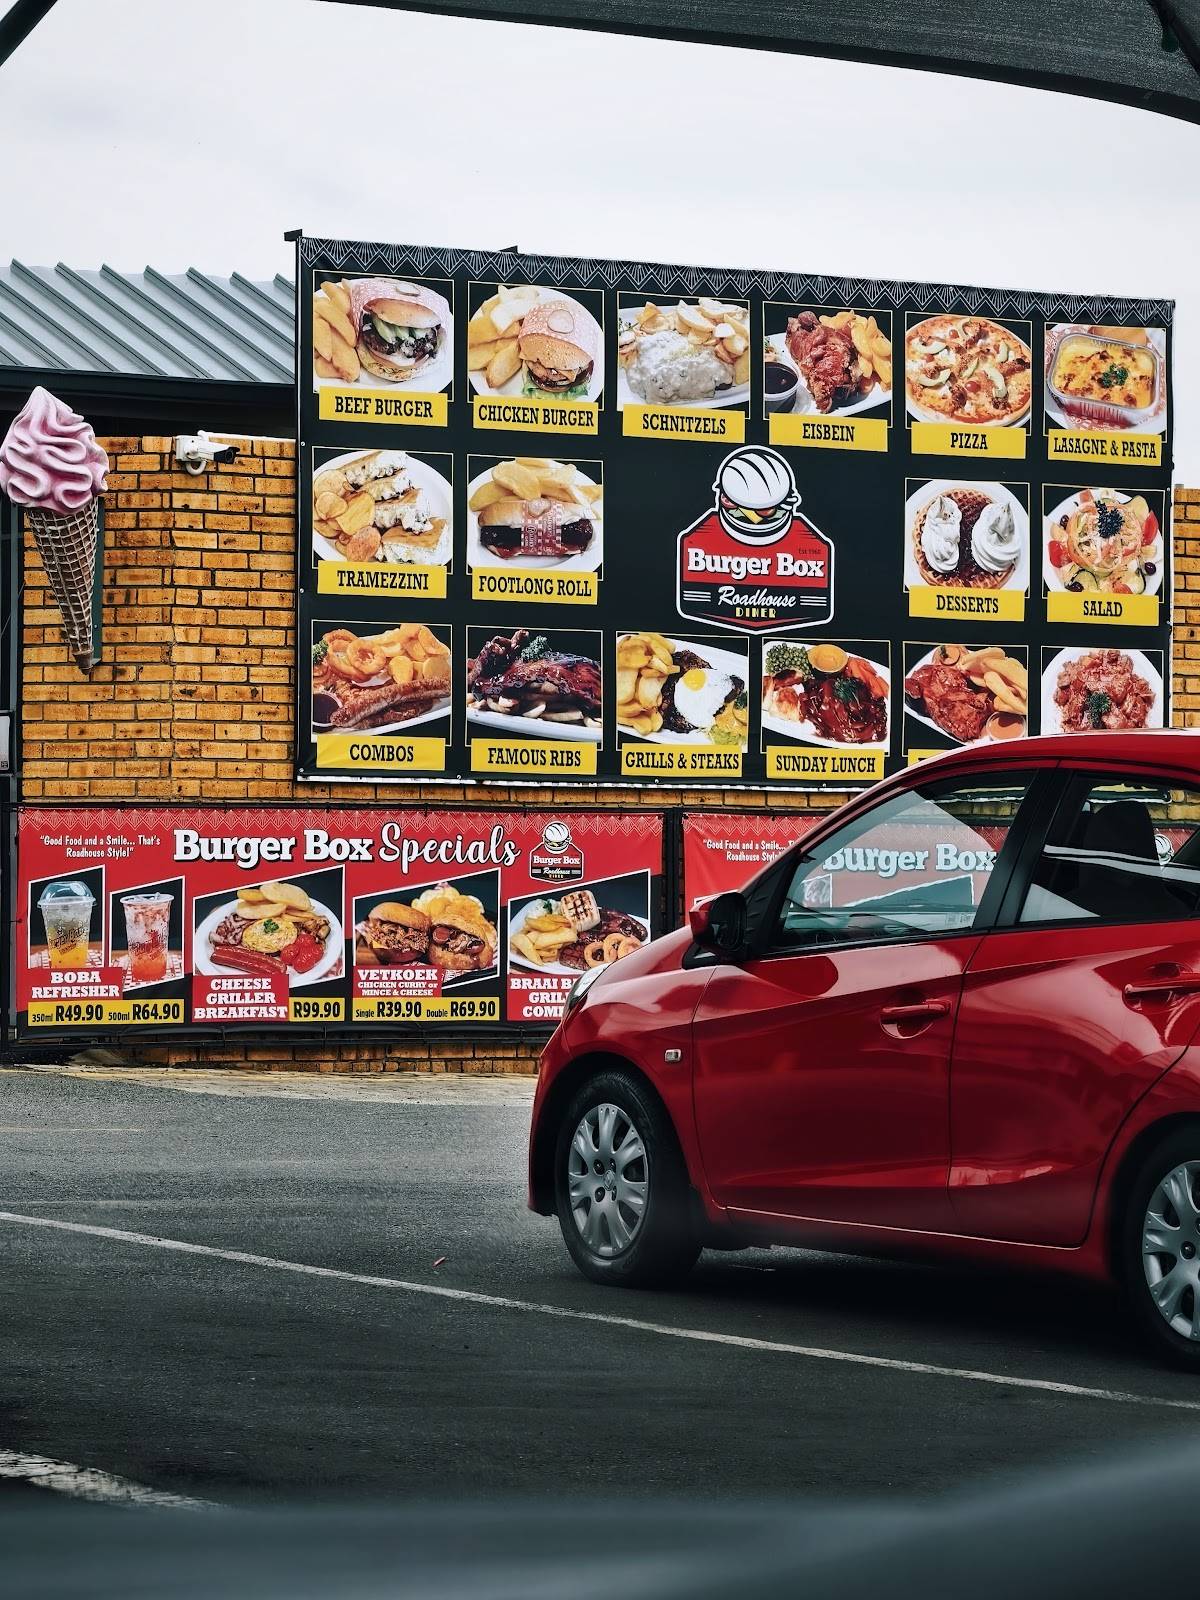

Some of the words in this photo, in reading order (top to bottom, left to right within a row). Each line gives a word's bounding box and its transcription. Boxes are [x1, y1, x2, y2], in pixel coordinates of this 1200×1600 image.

[334, 395, 373, 415] BEEF
[374, 398, 434, 419] BURGER
[478, 404, 540, 425] CHICKEN
[542, 408, 594, 428] BURGER
[642, 413, 726, 435] SCHNITZELS
[802, 423, 856, 443] EISBEIN
[950, 432, 989, 451] PIZZA
[1053, 437, 1107, 456] LASAGNE
[1109, 440, 1119, 457] &
[1121, 441, 1157, 459] PASTA
[687, 547, 772, 580] Burger
[776, 552, 825, 577] Box
[336, 569, 430, 591] TRAMEZZINI
[478, 574, 554, 595] FOOTLONG
[557, 578, 592, 598] ROLL
[717, 585, 797, 608] Roadhouse
[936, 594, 999, 614] DESSERTS
[735, 608, 777, 619] DINER
[1082, 599, 1123, 618] SALAD
[349, 744, 415, 763] COMBOS
[487, 747, 547, 766] FAMOUS
[549, 750, 582, 767] RIBS
[625, 751, 674, 769] GRILLS
[677, 751, 687, 769] &
[690, 752, 740, 770] STEAKS
[776, 754, 829, 772] SUNDAY
[831, 756, 876, 773] LUNCH
[65, 835, 82, 846] Food
[84, 836, 97, 846] and
[99, 837, 104, 845] a
[106, 834, 135, 846] Smile...
[138, 835, 161, 845] That's
[173, 829, 296, 868] Burger
[303, 829, 374, 863] Box
[379, 821, 521, 874] Specials
[725, 839, 741, 850] Food
[742, 840, 754, 850] and
[755, 842, 759, 850] a
[66, 847, 105, 858] Roadhouse
[533, 855, 562, 866] Burger
[563, 856, 581, 865] Box
[726, 851, 760, 862] Roadhouse
[822, 846, 929, 878] Burger
[935, 843, 998, 872] Box
[50, 971, 102, 984] BOBA
[210, 978, 272, 991] CHEESE
[357, 969, 438, 981] VETKOEK
[510, 978, 558, 990] BRAAI
[31, 985, 120, 999] REFRESHER
[357, 981, 397, 989] CHICKEN
[397, 981, 427, 989] CURRY
[206, 992, 276, 1004] GRILLER
[528, 991, 569, 1004] GRIL
[31, 1012, 53, 1023] 350ml
[55, 1003, 103, 1022] R49.90
[108, 1011, 130, 1021] 500ml
[132, 1002, 180, 1020] R64.90
[194, 1005, 288, 1019] BREAKFAST
[293, 1001, 341, 1018] R99.90
[355, 1009, 375, 1018] Single
[376, 1001, 422, 1018] R39.90
[426, 1008, 448, 1018] Double
[450, 1000, 496, 1017] R69.90
[522, 1005, 564, 1018] COM
